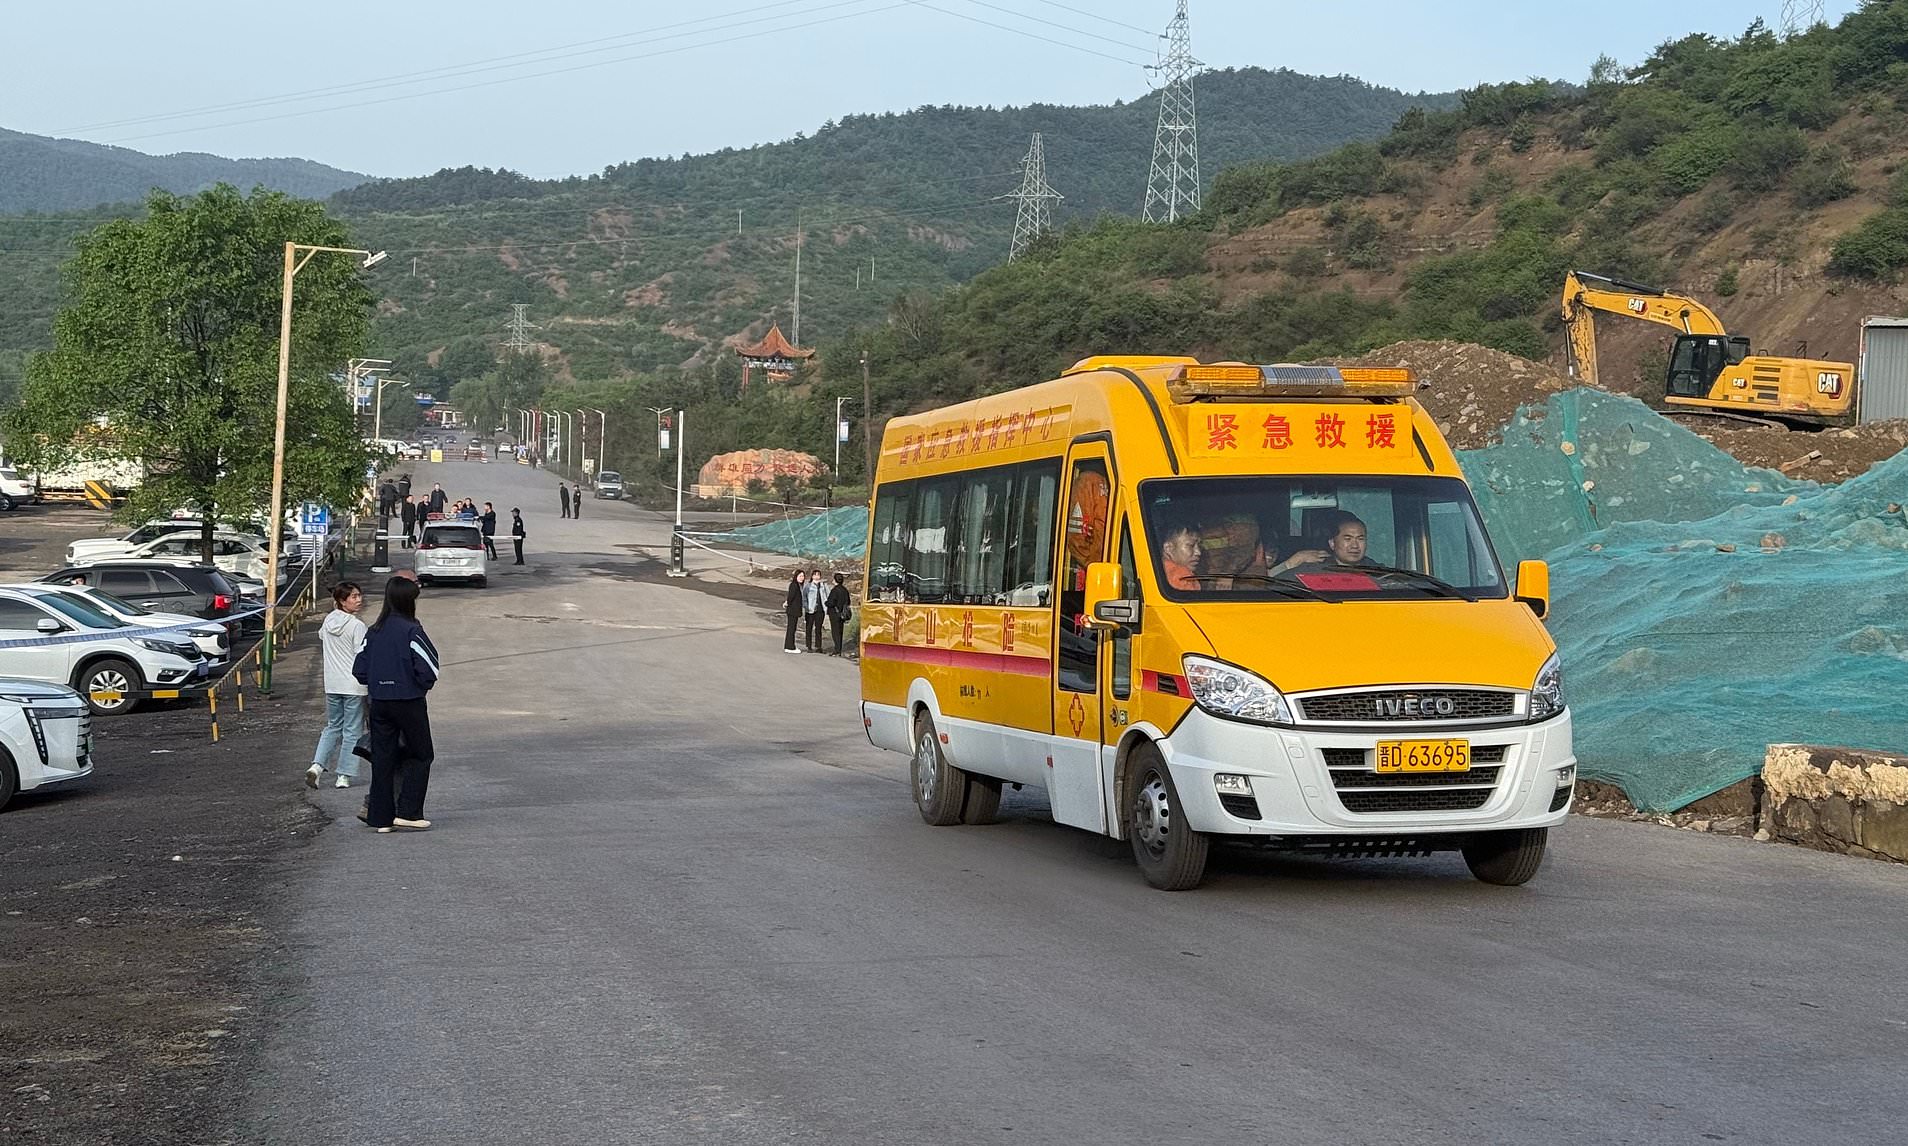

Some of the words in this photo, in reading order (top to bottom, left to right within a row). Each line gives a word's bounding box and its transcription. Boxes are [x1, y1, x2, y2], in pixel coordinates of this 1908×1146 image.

[1628, 298, 1645, 312] CAT
[1732, 378, 1745, 387] CAT
[1818, 373, 1839, 393] CAT
[1207, 412, 1396, 451] 紧急救援
[1375, 697, 1455, 716] IVECO
